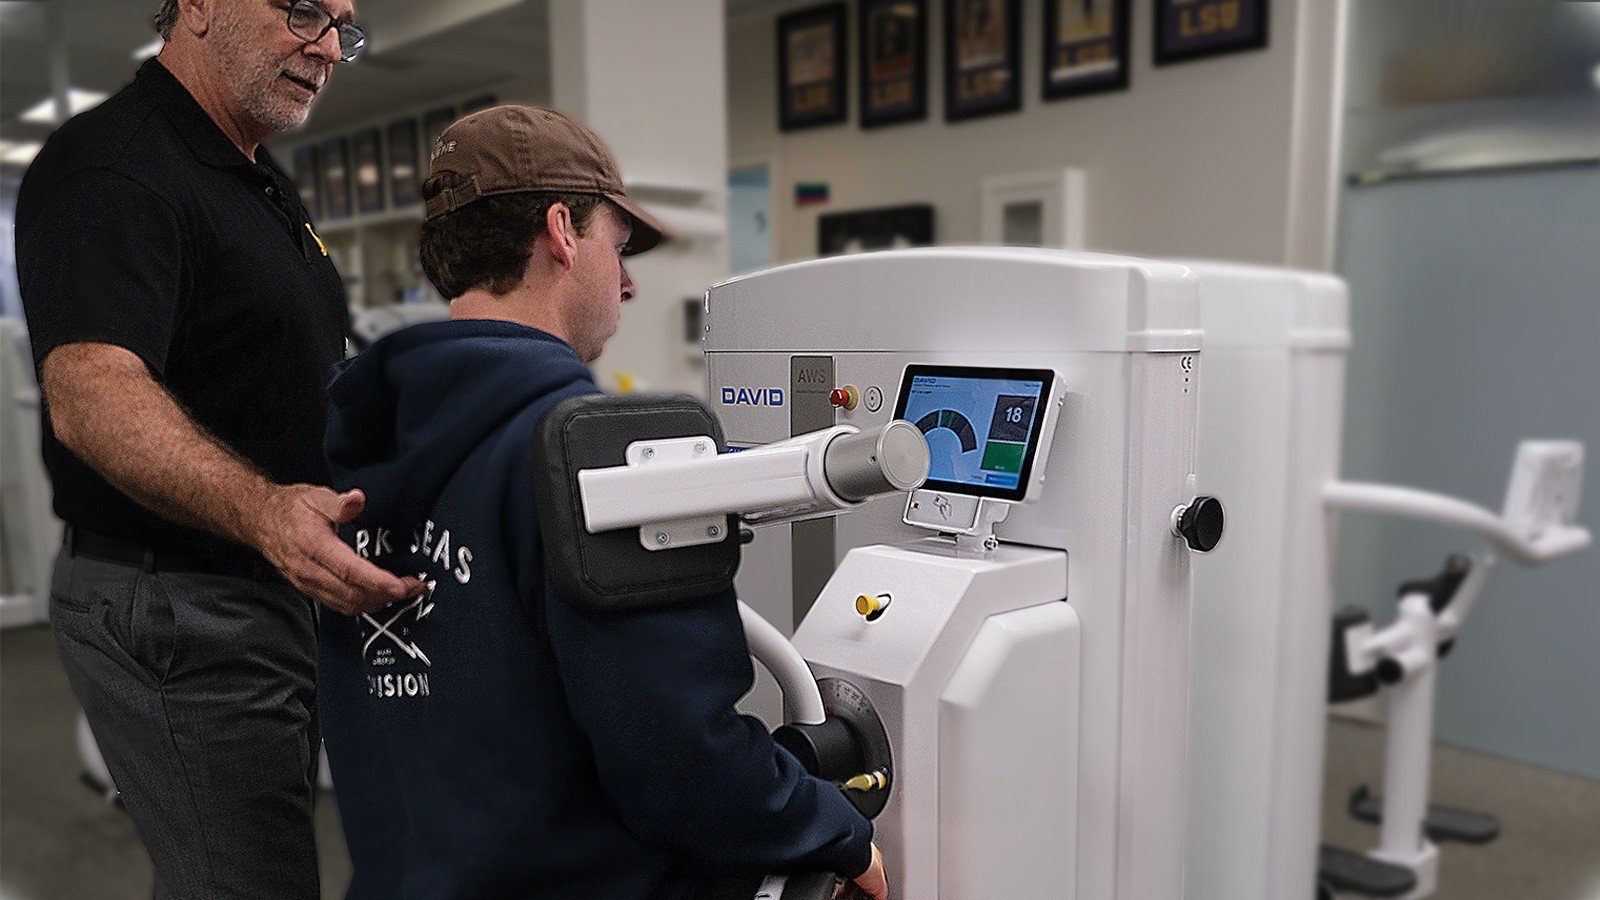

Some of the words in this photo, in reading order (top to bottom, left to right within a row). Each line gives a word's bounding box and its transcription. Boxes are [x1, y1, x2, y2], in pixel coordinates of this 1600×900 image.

[1180, 1, 1239, 38] LSU
[872, 81, 911, 107] LSU
[961, 73, 1004, 99] LSU
[797, 368, 826, 384] AWS
[722, 387, 784, 406] DAVID
[1005, 406, 1022, 423] 18
[356, 526, 393, 558] RK
